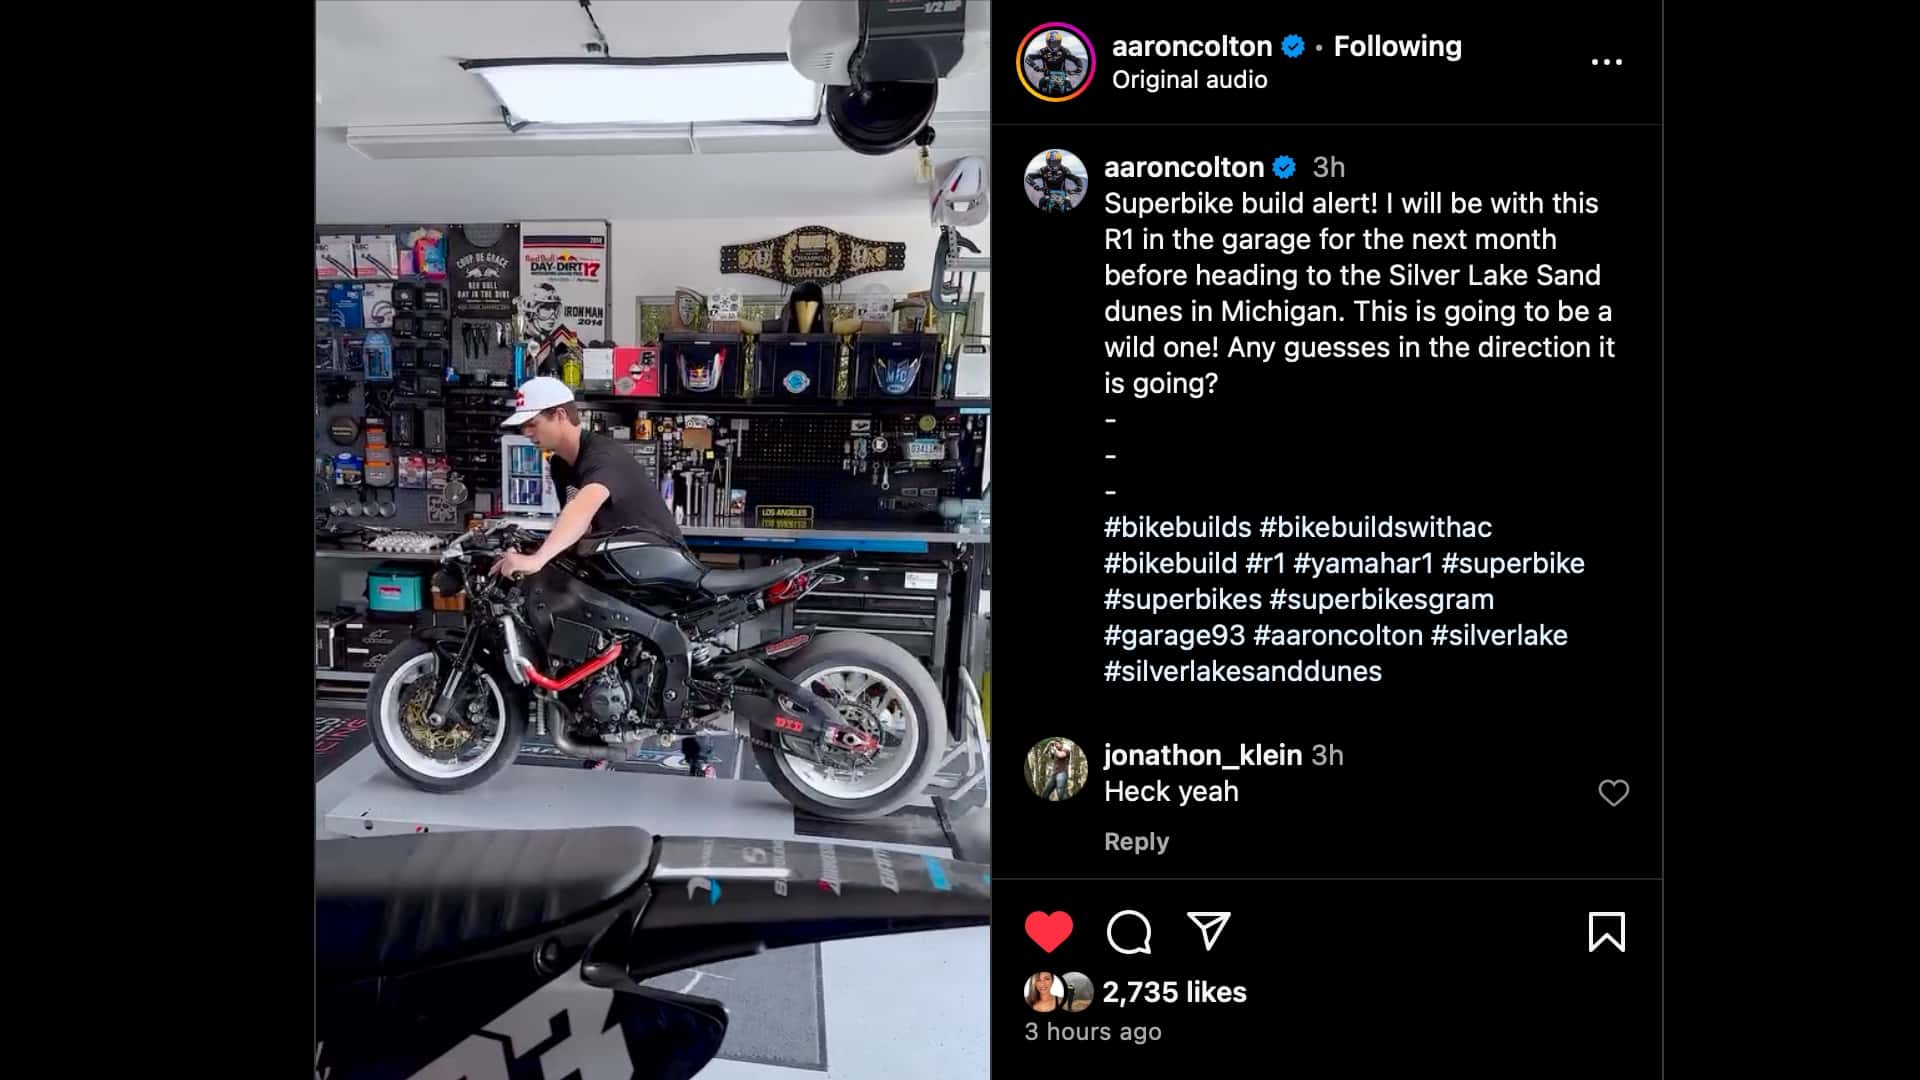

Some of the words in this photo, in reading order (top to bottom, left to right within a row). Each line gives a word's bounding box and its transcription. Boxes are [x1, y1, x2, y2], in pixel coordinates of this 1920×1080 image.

[531, 262, 553, 271] DAY
[556, 262, 582, 271] DIRT
[583, 262, 600, 277] 17
[578, 318, 603, 326] 2014
